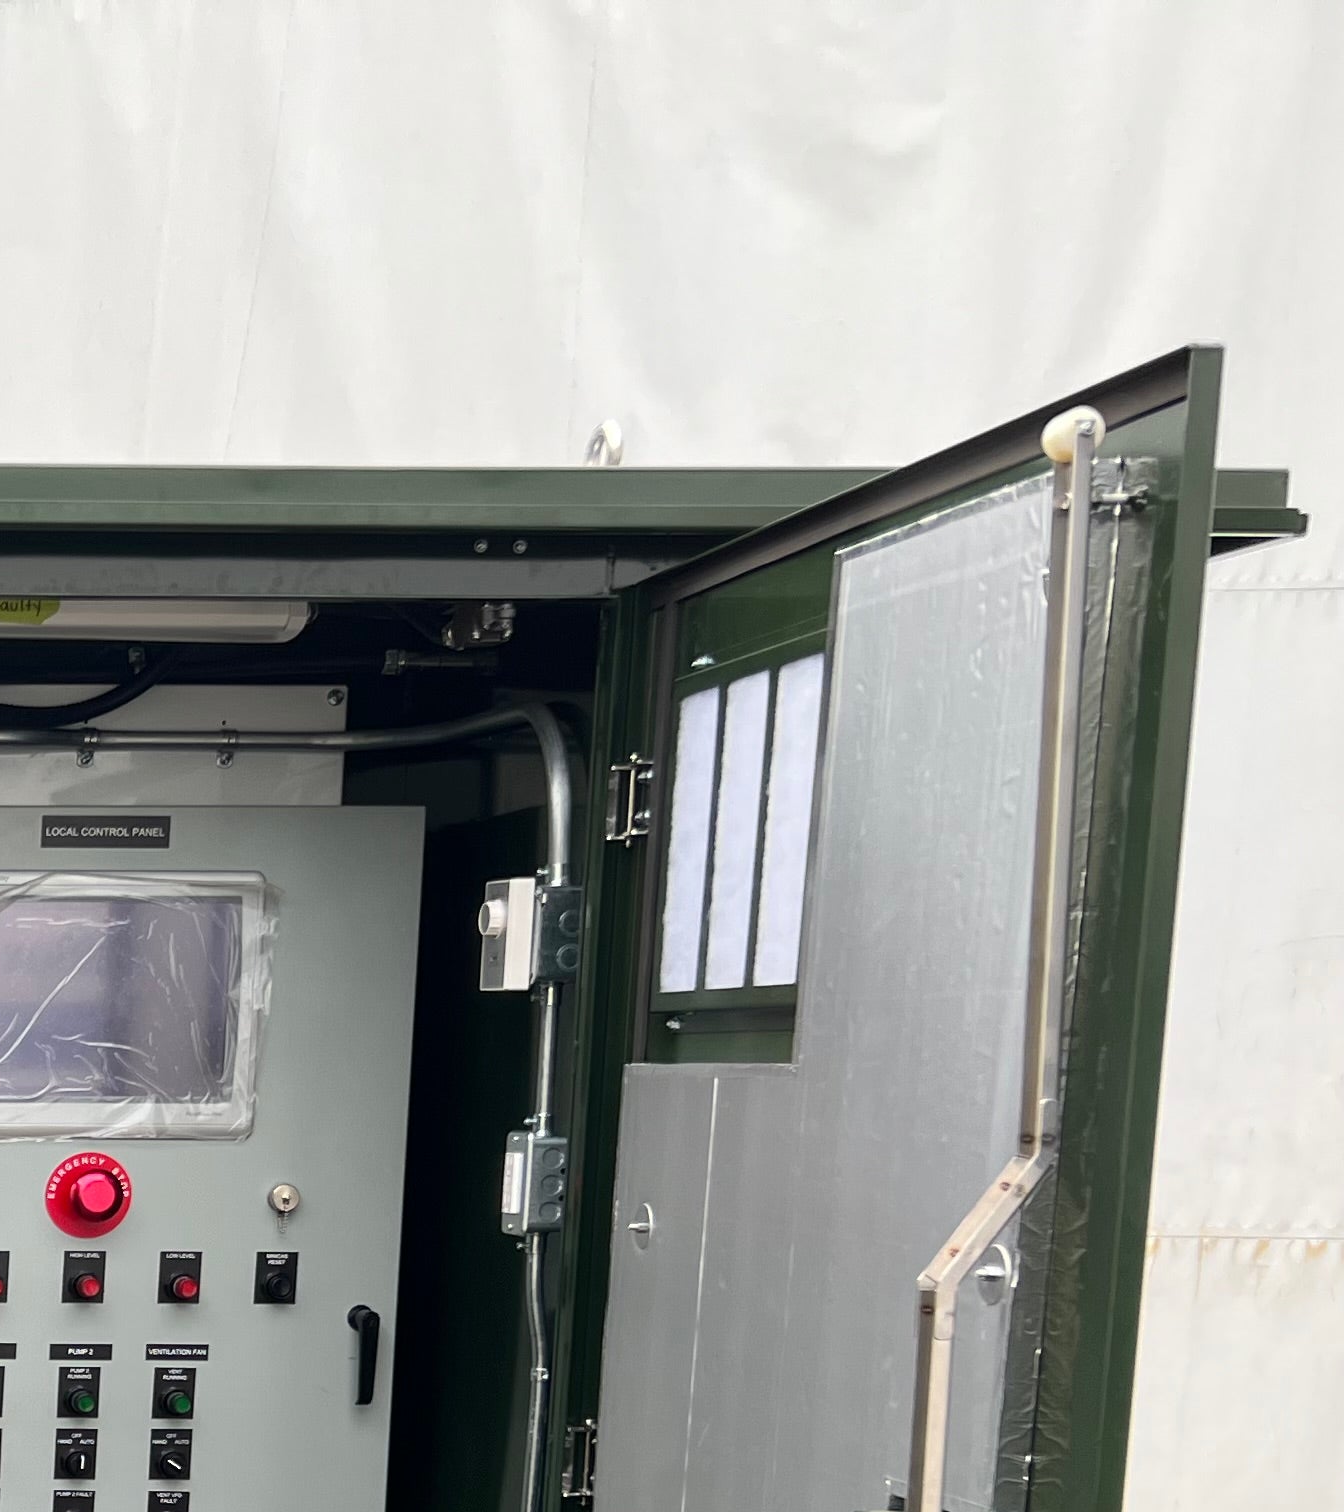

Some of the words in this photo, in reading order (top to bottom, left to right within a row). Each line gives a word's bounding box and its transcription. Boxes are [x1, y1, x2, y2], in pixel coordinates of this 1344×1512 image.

[46, 827, 79, 837] LOCAL
[81, 827, 129, 837] CONTROL
[132, 828, 165, 838] PANEL
[47, 1156, 105, 1199] EMERGENCY
[111, 1167, 130, 1198] STOP
